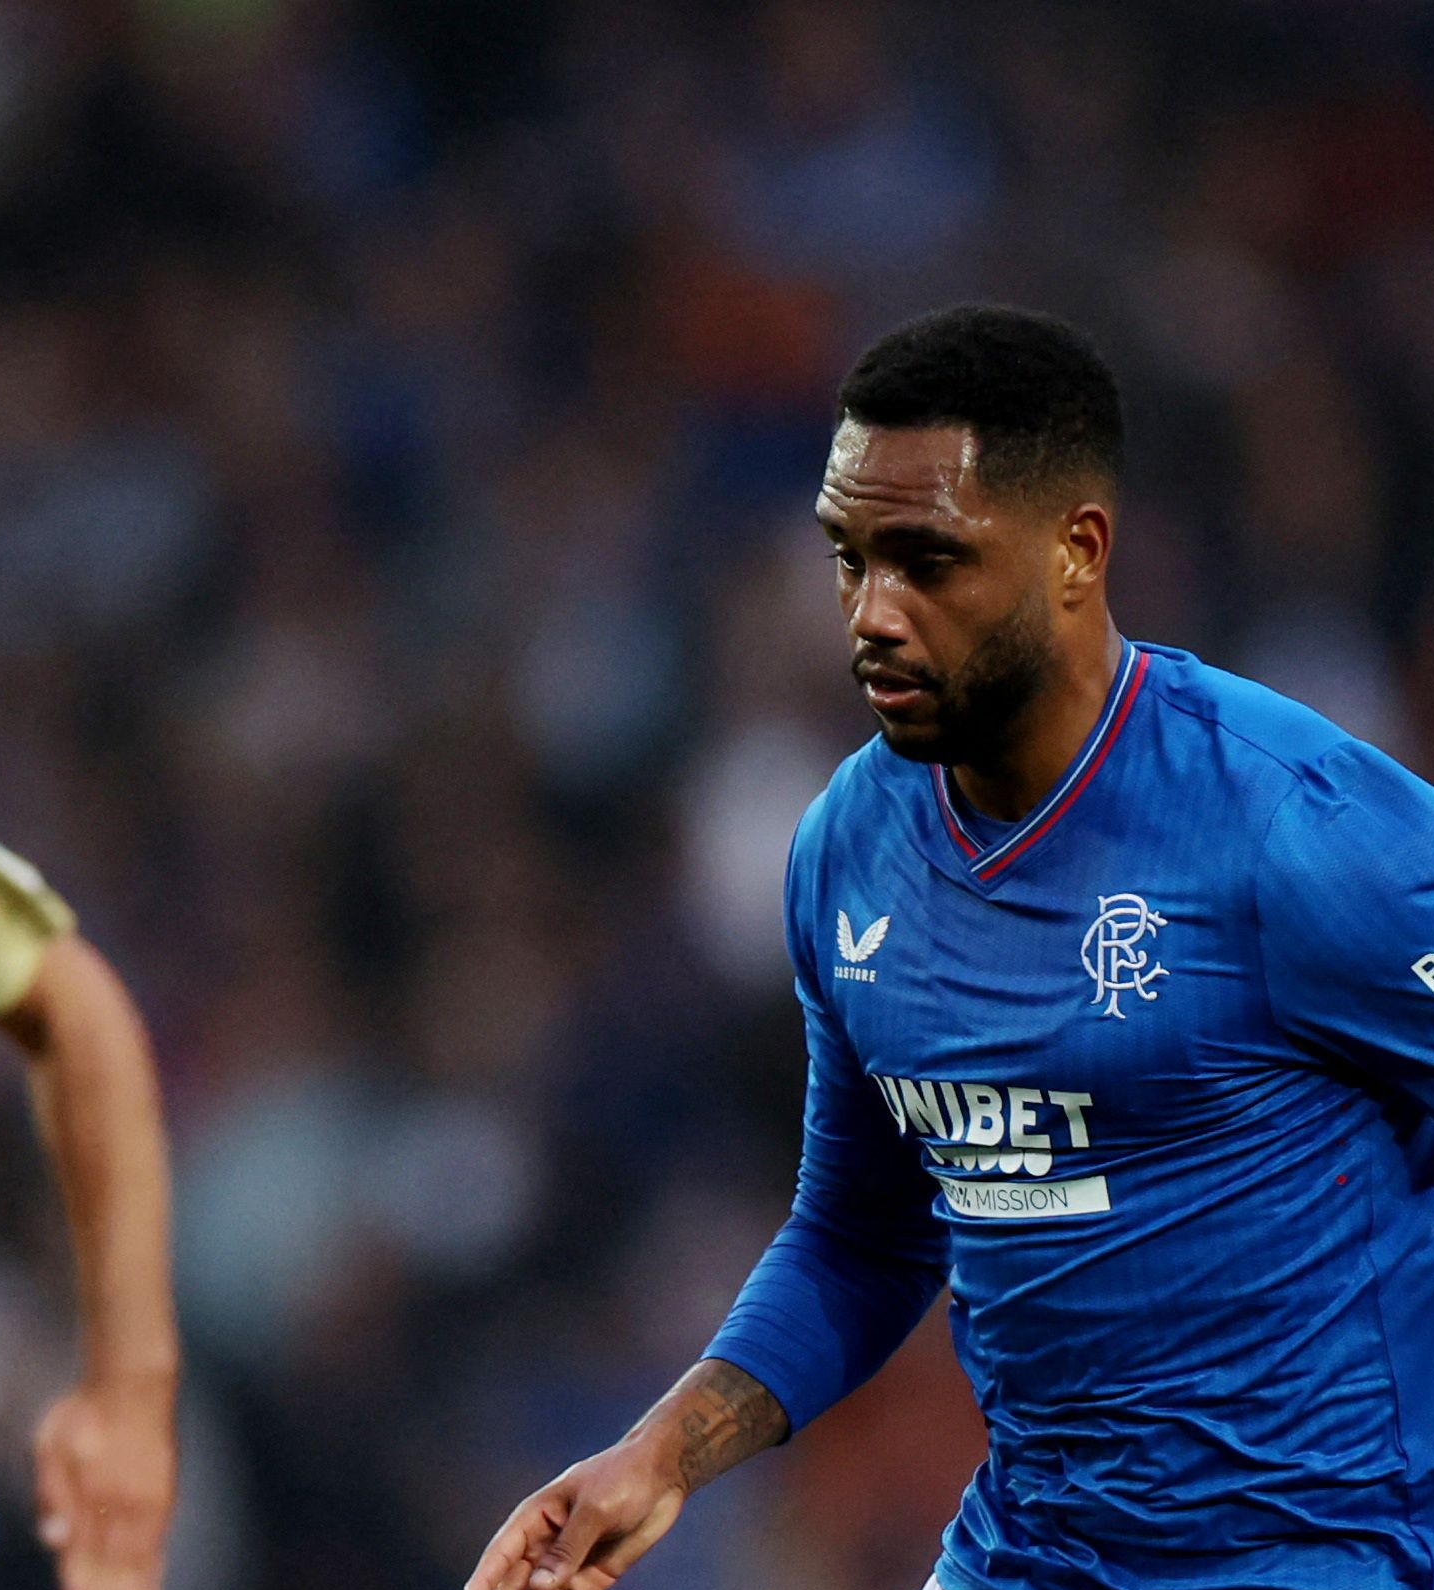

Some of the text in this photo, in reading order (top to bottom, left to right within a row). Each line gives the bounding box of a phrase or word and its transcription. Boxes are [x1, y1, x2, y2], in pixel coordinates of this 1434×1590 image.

[834, 965, 877, 983] CASTORE
[871, 1073, 1094, 1149] UNIBET
[975, 1186, 1069, 1212] MISSION
